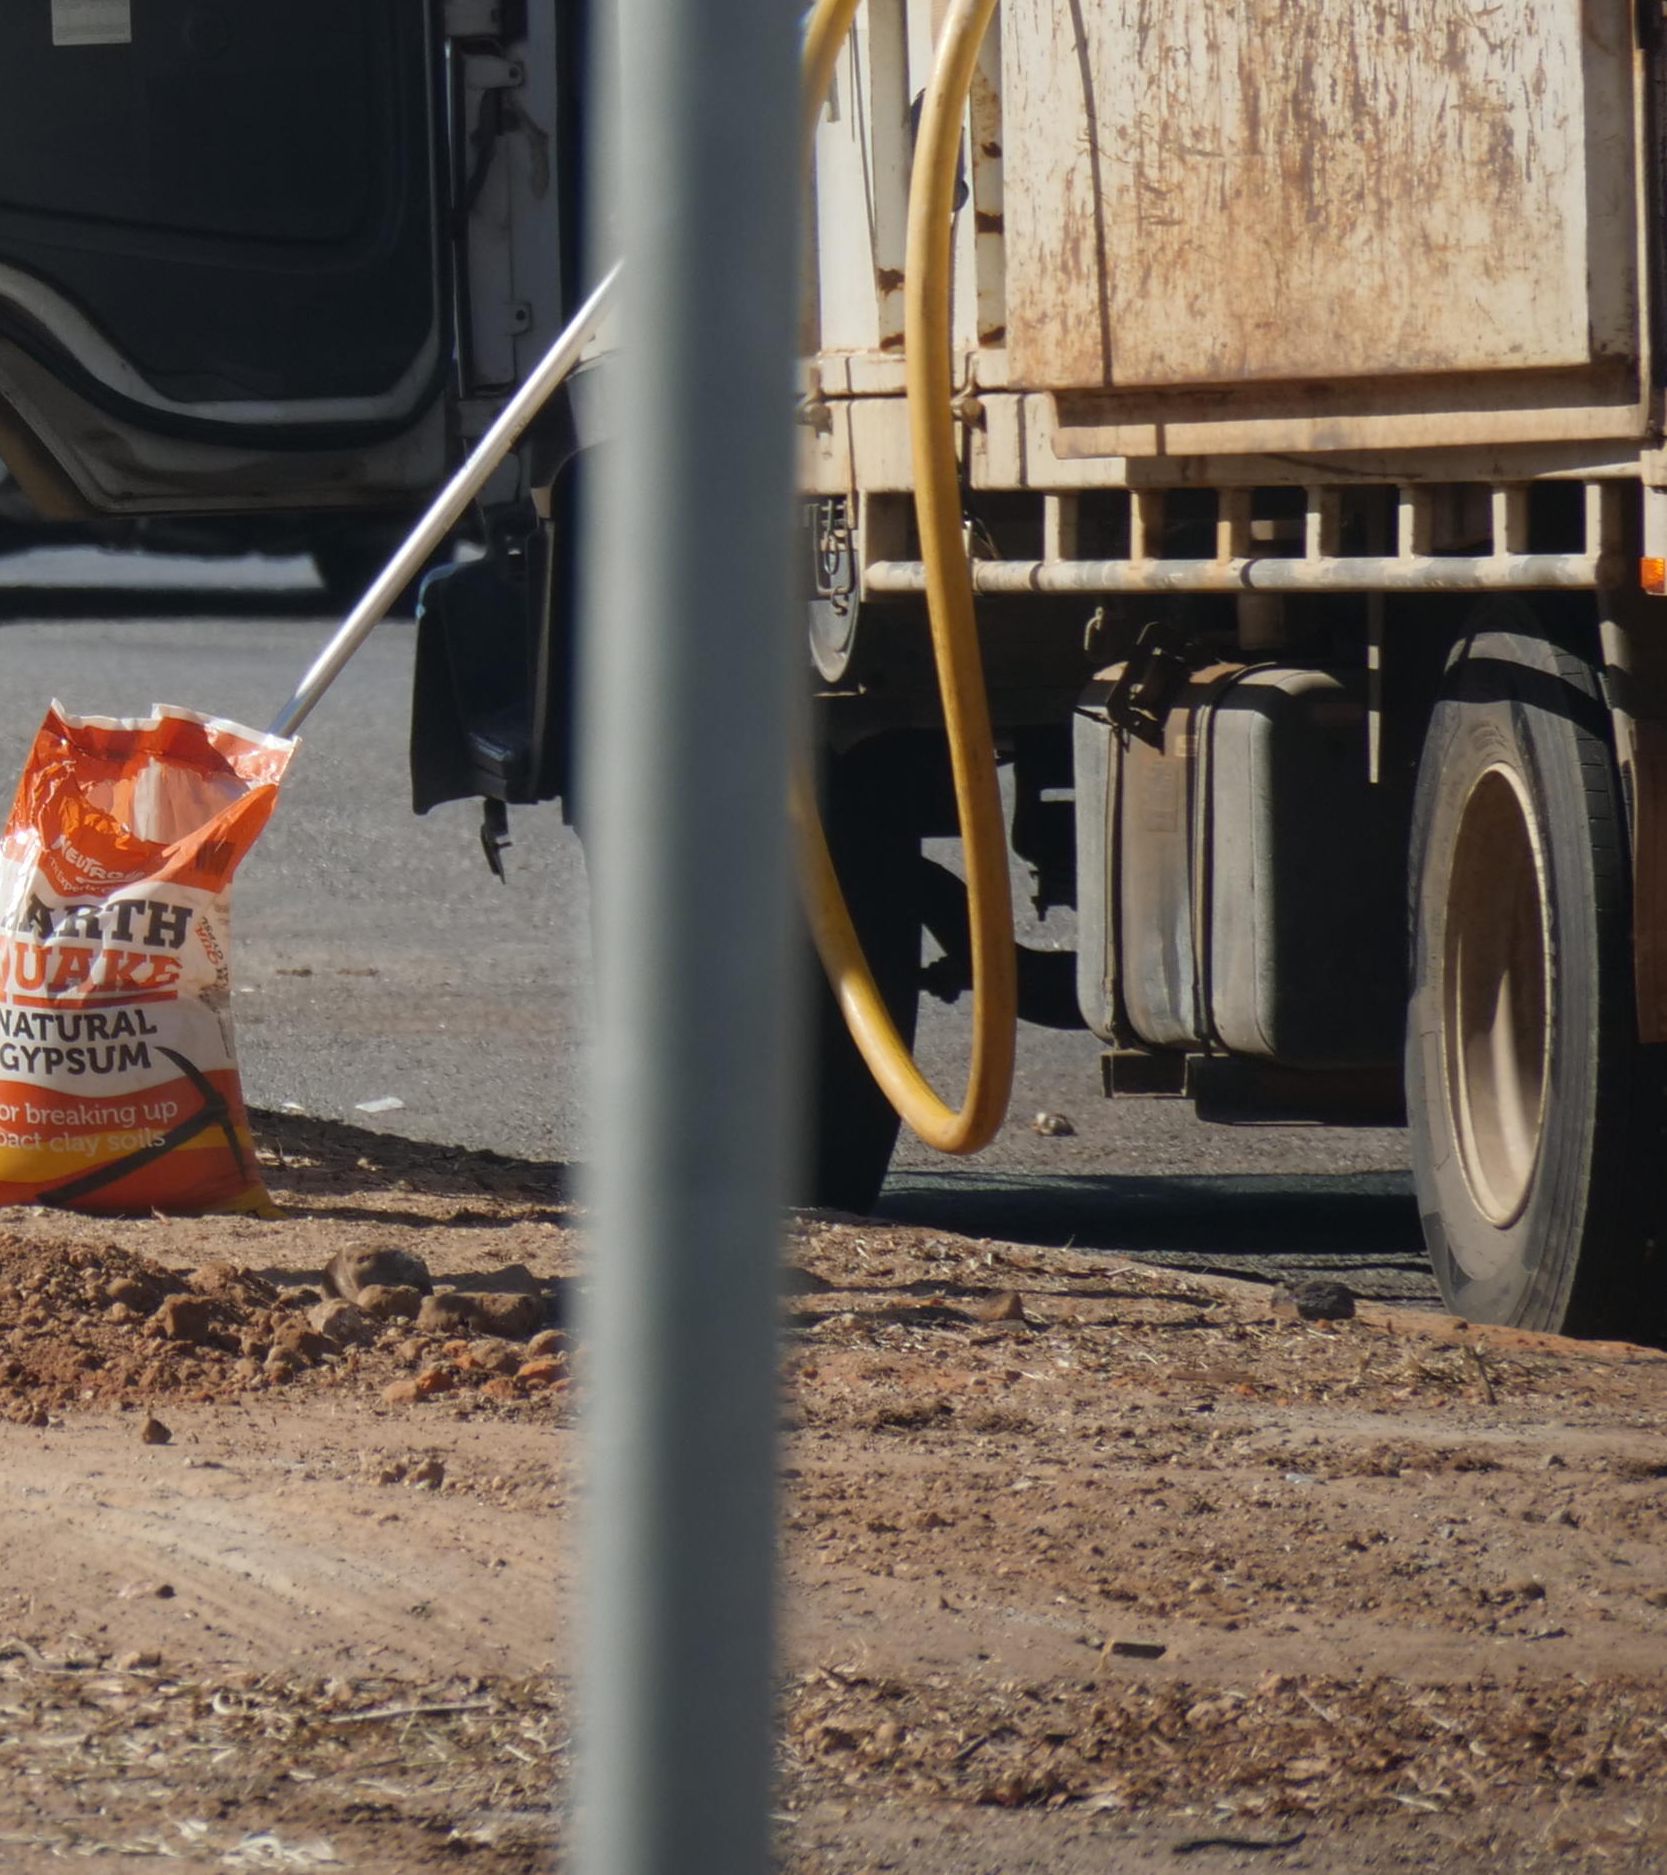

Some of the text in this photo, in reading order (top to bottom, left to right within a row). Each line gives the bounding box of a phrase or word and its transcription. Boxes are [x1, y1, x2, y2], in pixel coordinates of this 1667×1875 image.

[2, 893, 193, 949] ARTH
[24, 1101, 136, 1128] breaking
[143, 1100, 179, 1123] up
[49, 1131, 101, 1158] clay
[107, 1127, 166, 1151] soils
